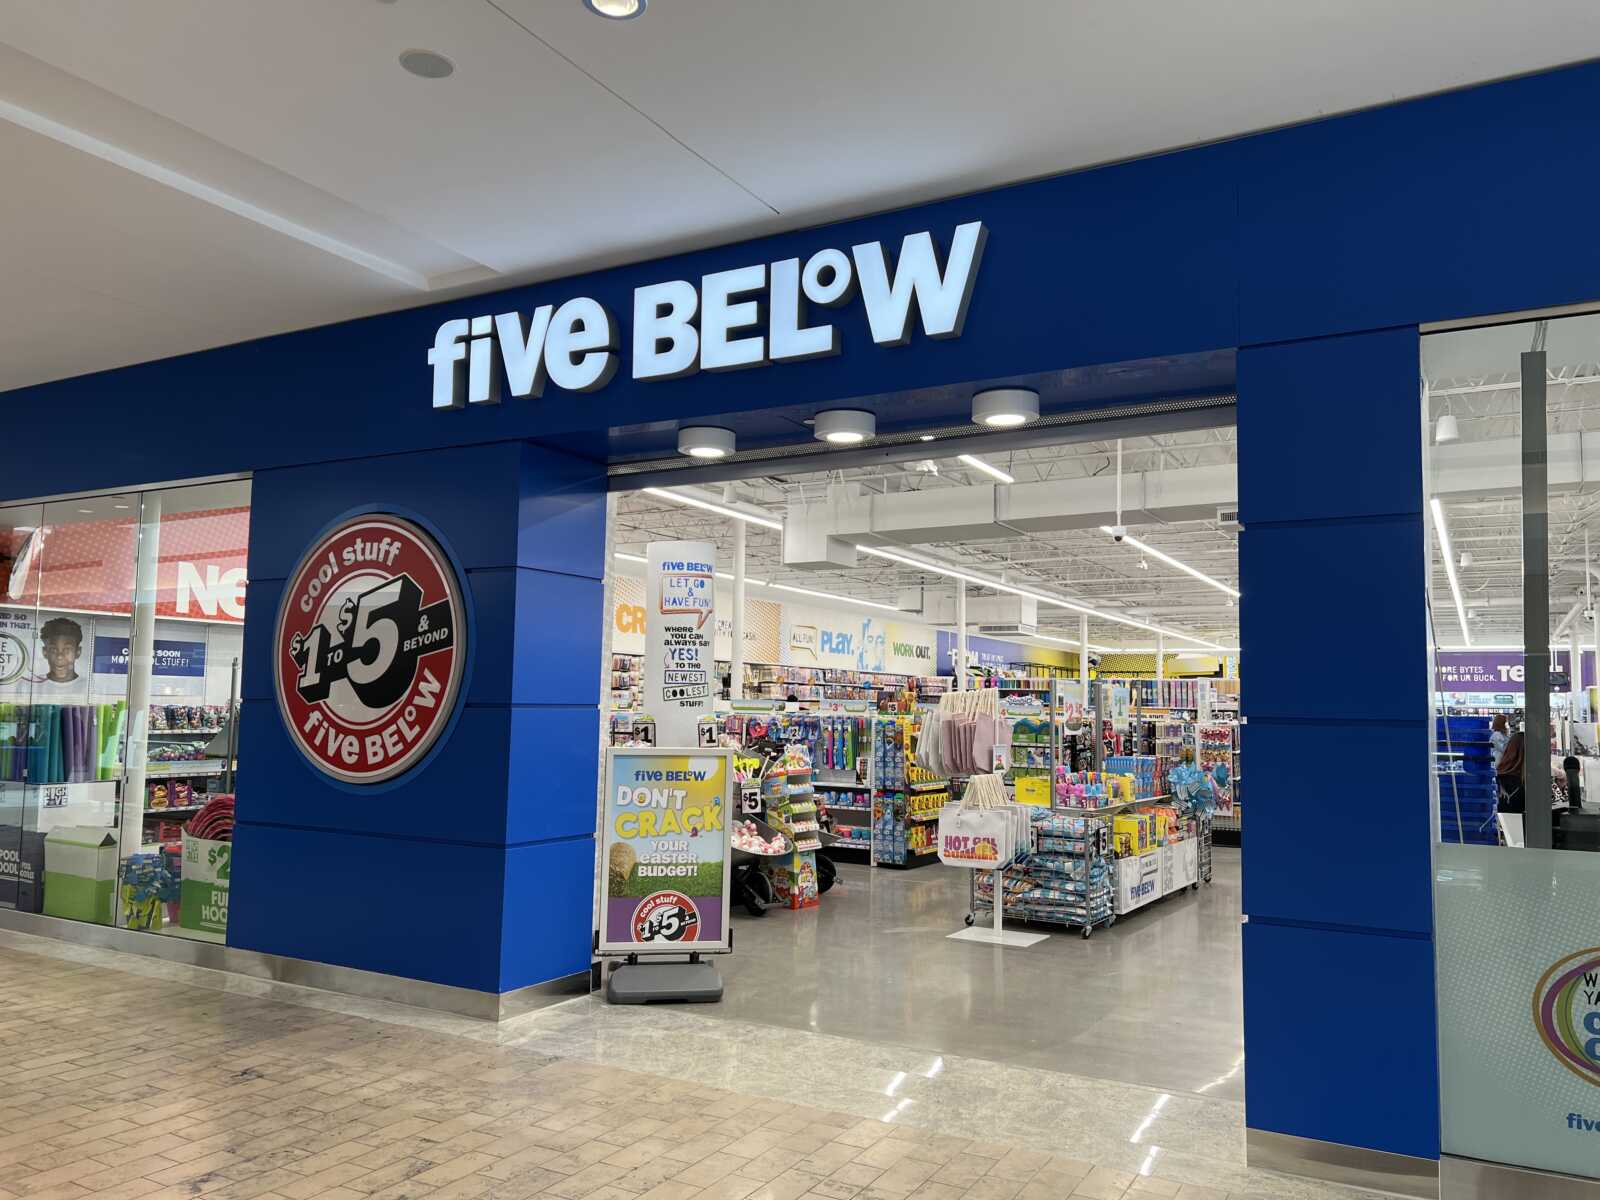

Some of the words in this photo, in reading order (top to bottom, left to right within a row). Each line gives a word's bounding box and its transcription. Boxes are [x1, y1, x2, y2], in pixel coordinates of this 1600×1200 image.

[427, 296, 616, 409] five
[662, 561, 684, 571] five
[300, 552, 339, 613] cool
[342, 537, 402, 568] stuff
[670, 579, 689, 588] LET
[694, 579, 705, 588] GO
[687, 588, 694, 597] &
[664, 597, 689, 607] HAVE
[418, 614, 429, 632] &
[403, 627, 449, 652] BEYOND
[156, 650, 181, 658] SOON
[327, 648, 343, 666] TO
[669, 648, 699, 661] YES!
[892, 642, 914, 657] WORK
[161, 657, 189, 667] STUFF!
[667, 673, 703, 683] NEWEST
[1442, 674, 1457, 682] FOR
[665, 686, 705, 698] COOLEST
[304, 710, 360, 765] five
[635, 726, 652, 744] $1
[700, 727, 716, 745] $1
[634, 770, 662, 782] five
[616, 785, 686, 810] DON'T
[743, 793, 759, 811] $5
[615, 805, 724, 839] CRACK
[650, 840, 688, 851] YOUR
[944, 835, 969, 851] HOT
[202, 904, 228, 921] HOO
[640, 900, 655, 917] cool
[656, 895, 678, 904] stuff
